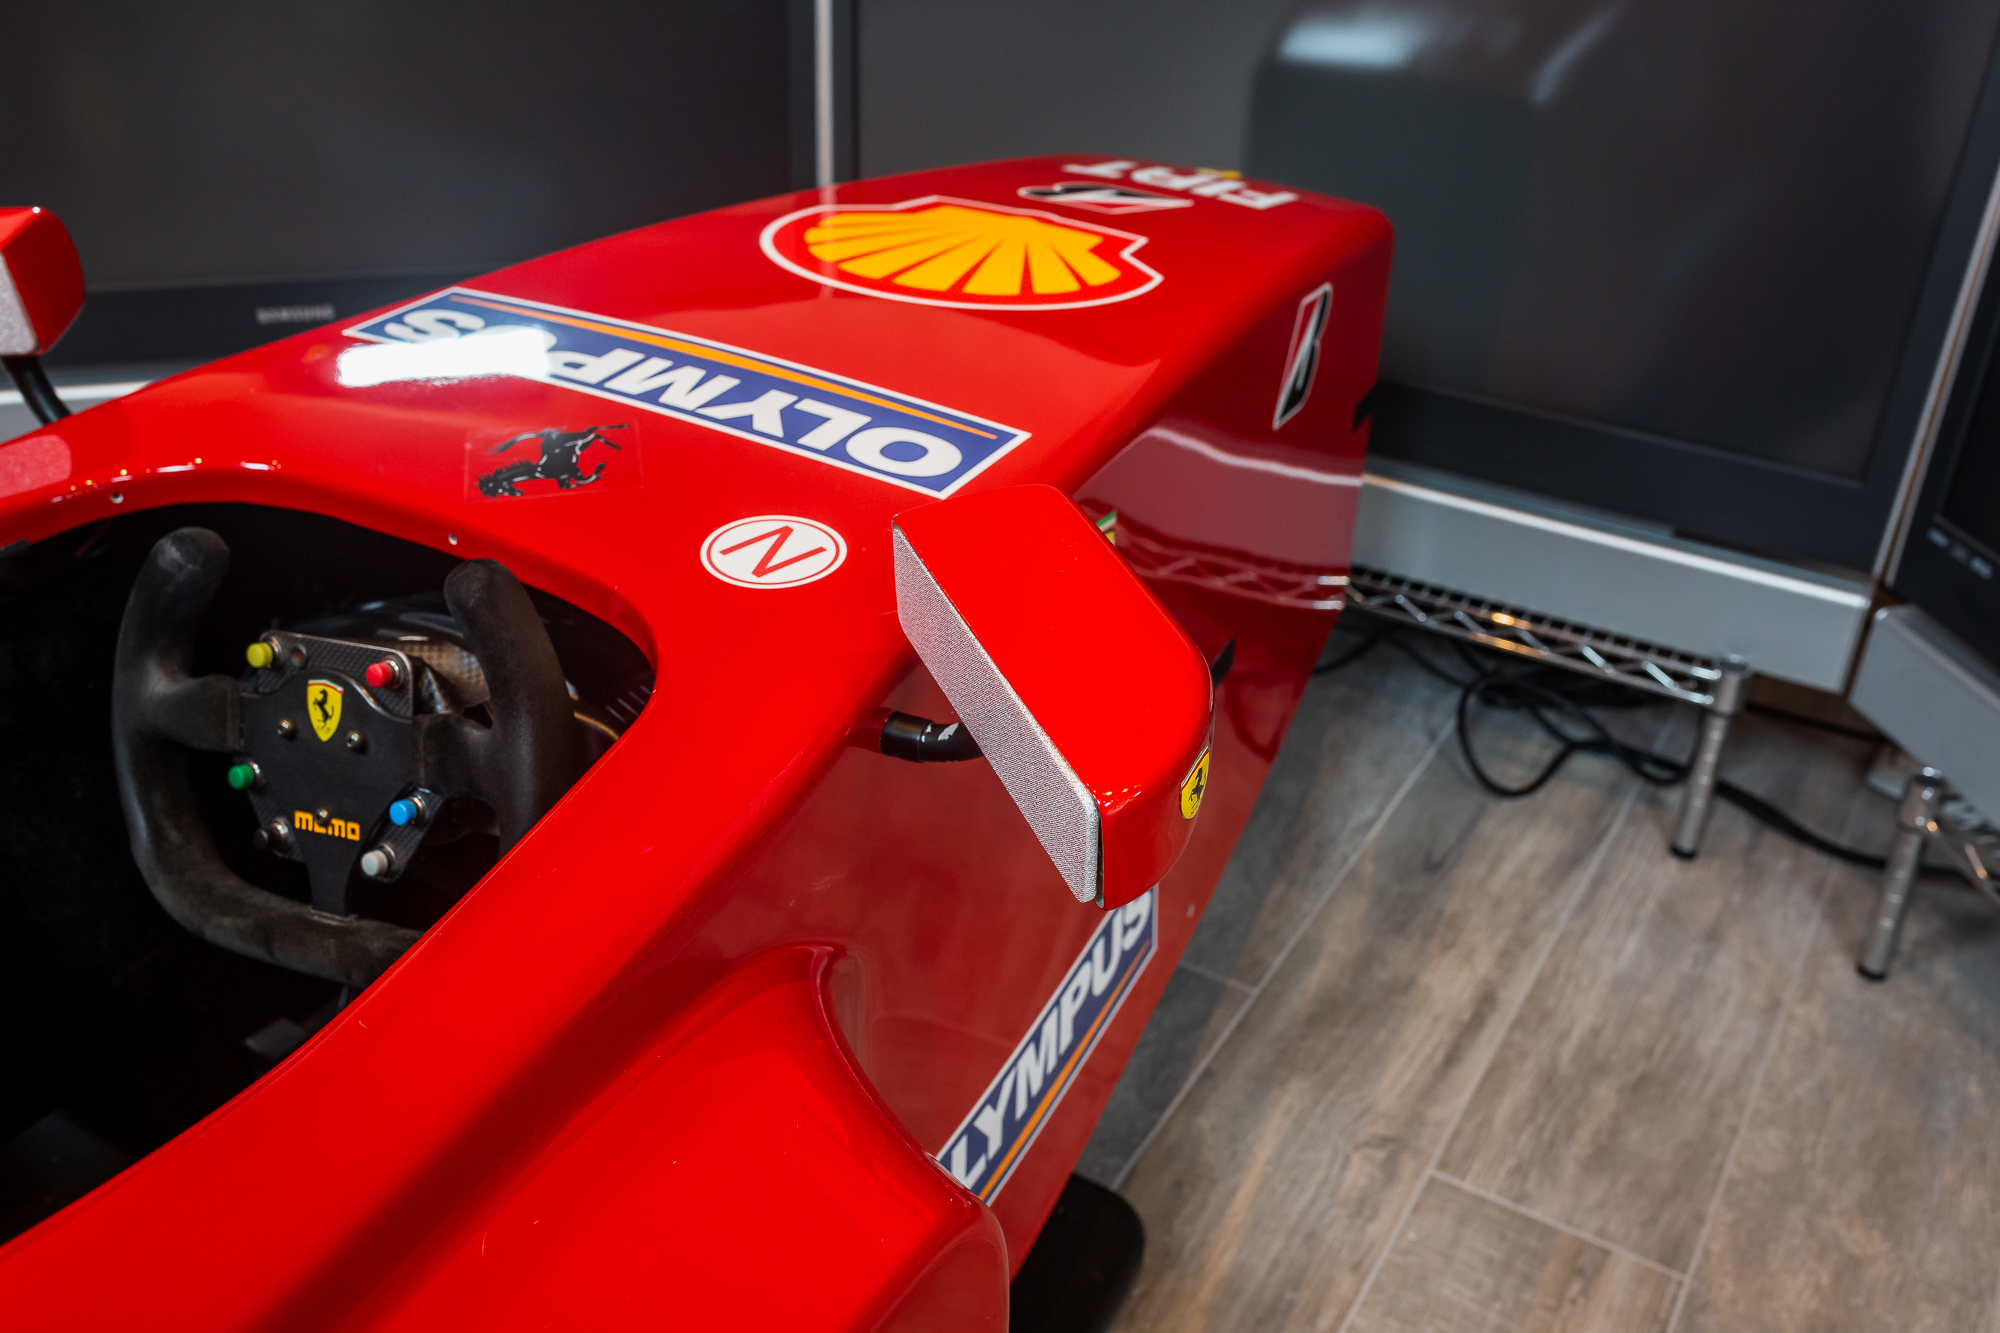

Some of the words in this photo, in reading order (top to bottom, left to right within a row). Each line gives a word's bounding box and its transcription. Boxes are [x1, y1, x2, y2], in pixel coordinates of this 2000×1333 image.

[1061, 160, 1298, 210] FIAT
[384, 308, 963, 477] OLYMPS
[951, 891, 1152, 1190] LYMPUS
